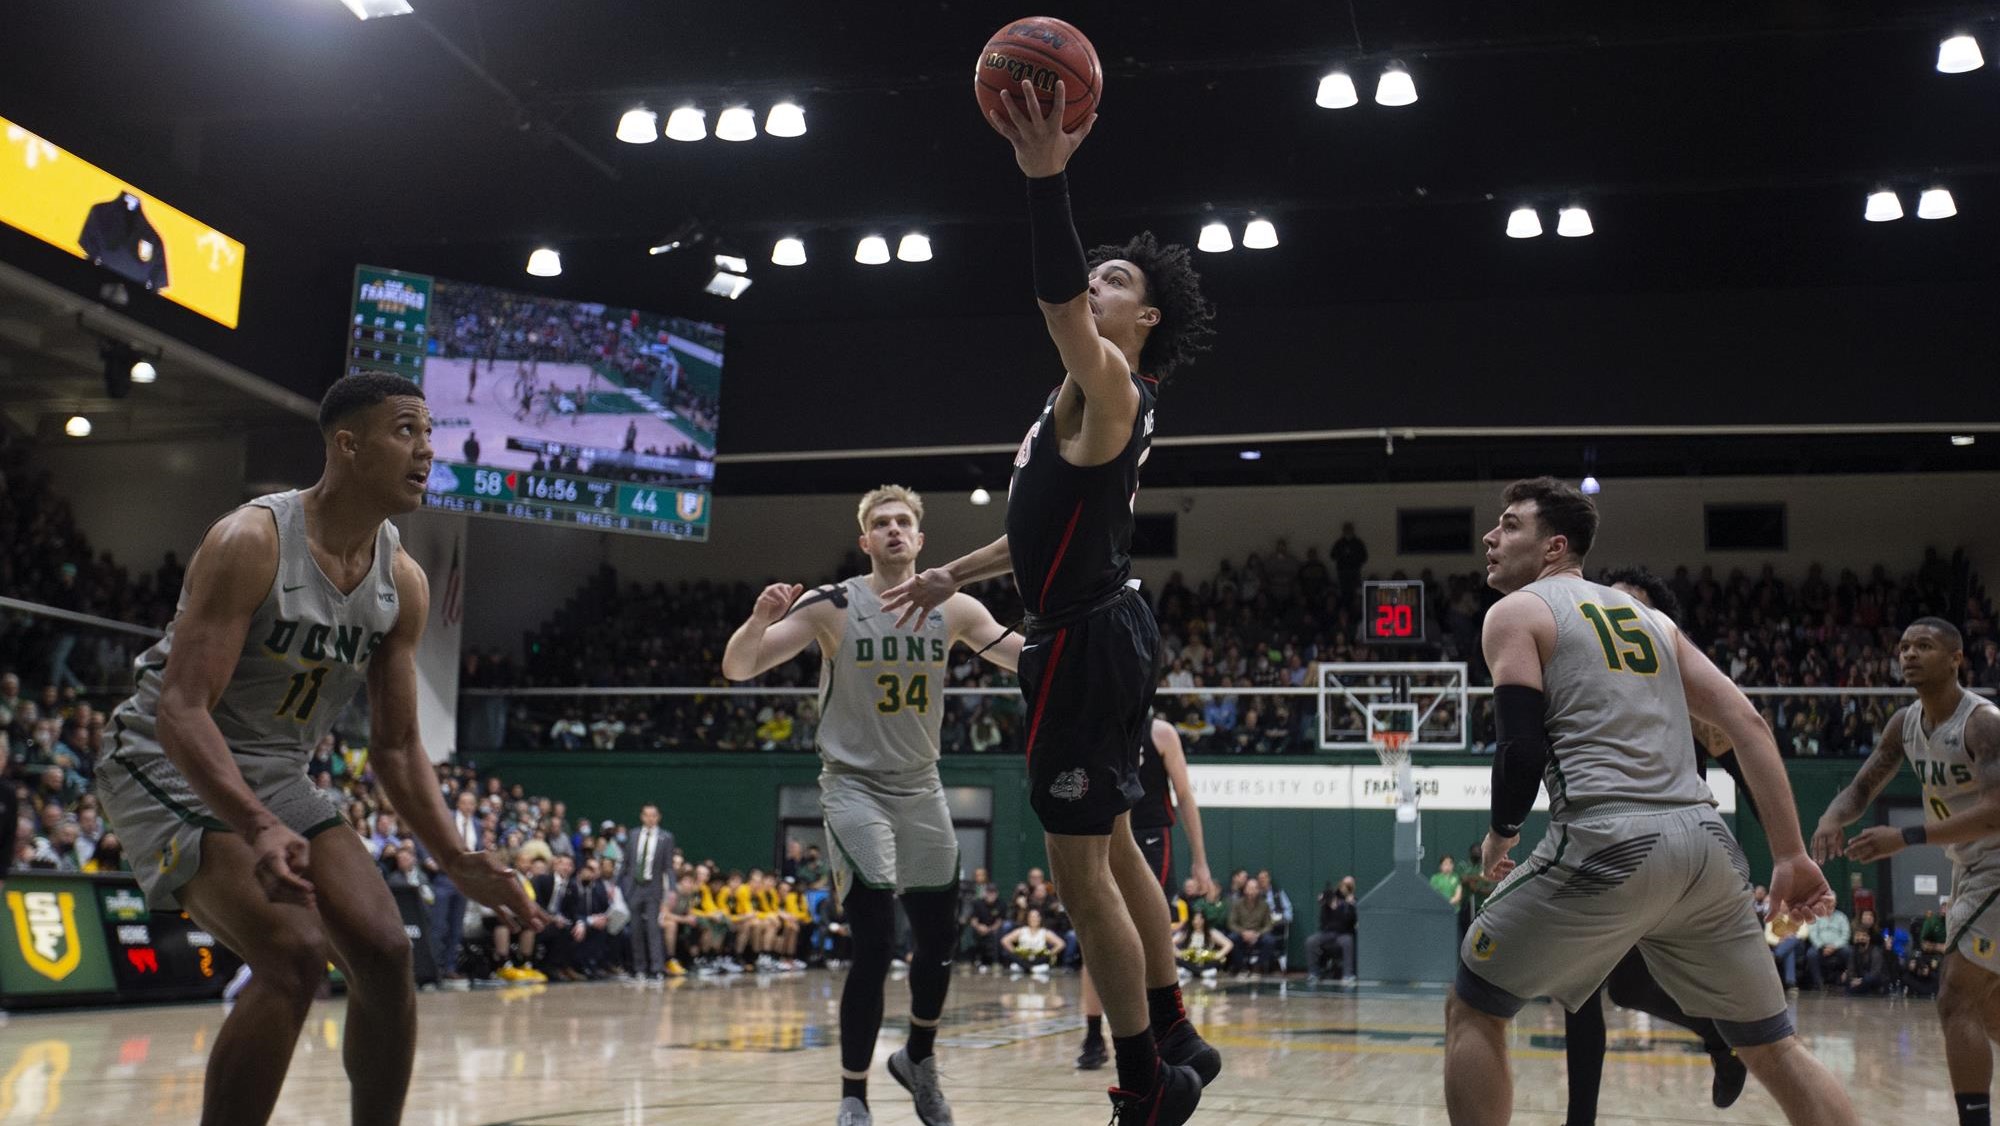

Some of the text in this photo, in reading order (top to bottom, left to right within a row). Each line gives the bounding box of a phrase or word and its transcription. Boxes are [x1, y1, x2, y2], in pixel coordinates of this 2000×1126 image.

[985, 53, 1060, 94] Wilson
[474, 469, 502, 496] 58
[526, 475, 578, 502] 16:56
[631, 489, 657, 514] 44
[262, 619, 385, 665] DONS
[1376, 605, 1412, 636] 20
[1577, 601, 1659, 676] 15
[856, 635, 944, 664] DONS
[274, 667, 330, 724] 11
[876, 673, 929, 716] 34
[1190, 779, 1338, 795] NIVERSITY OF
